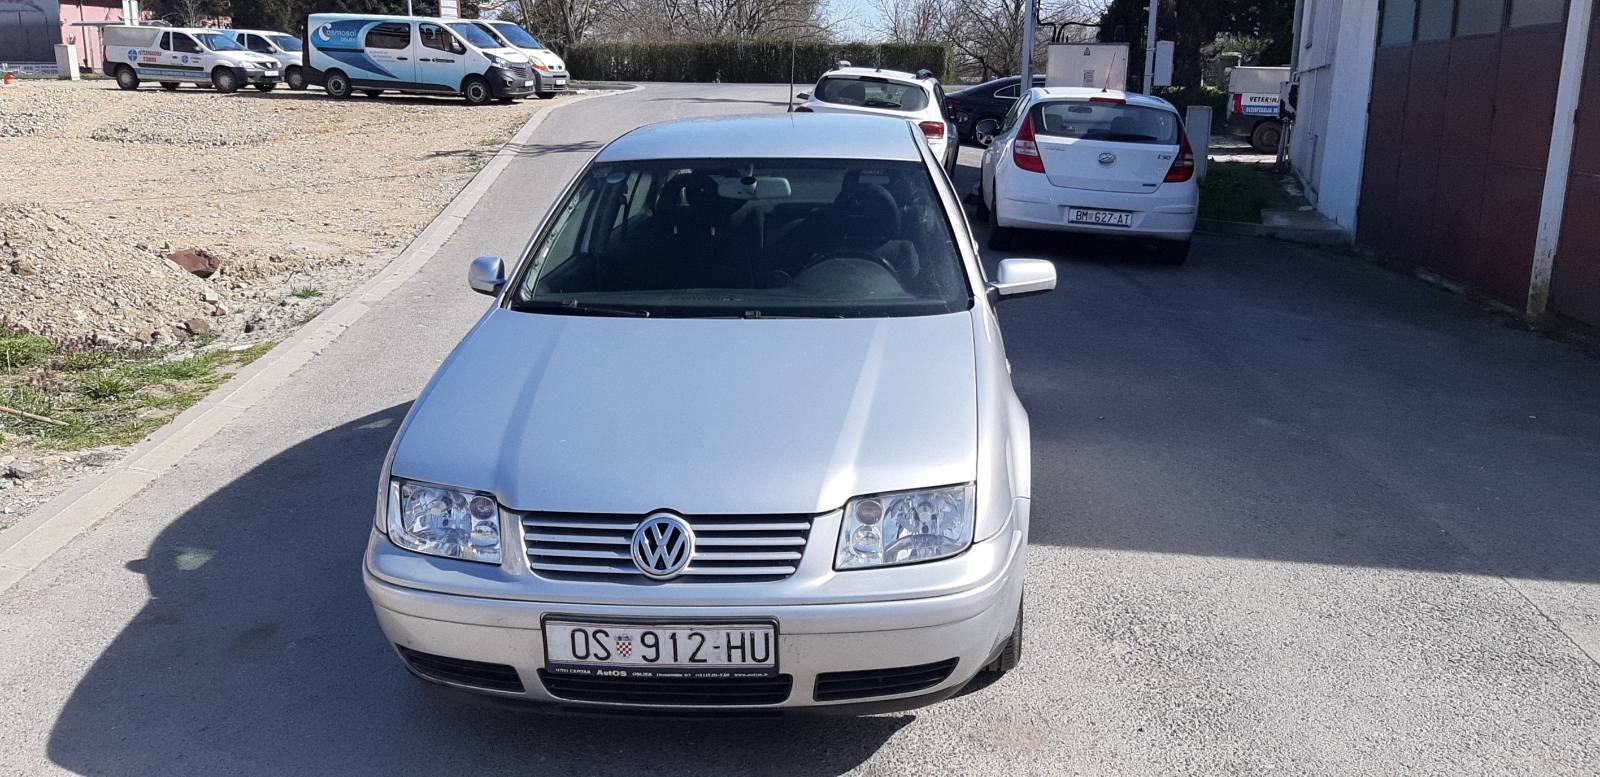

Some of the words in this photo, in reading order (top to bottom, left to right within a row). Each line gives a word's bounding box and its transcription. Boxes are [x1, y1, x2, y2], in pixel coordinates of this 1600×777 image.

[1075, 210, 1089, 221] BM
[1094, 212, 1130, 225] 627-AT
[570, 628, 611, 661] OS
[639, 631, 770, 663] 912-HU
[596, 669, 627, 677] AutOS
